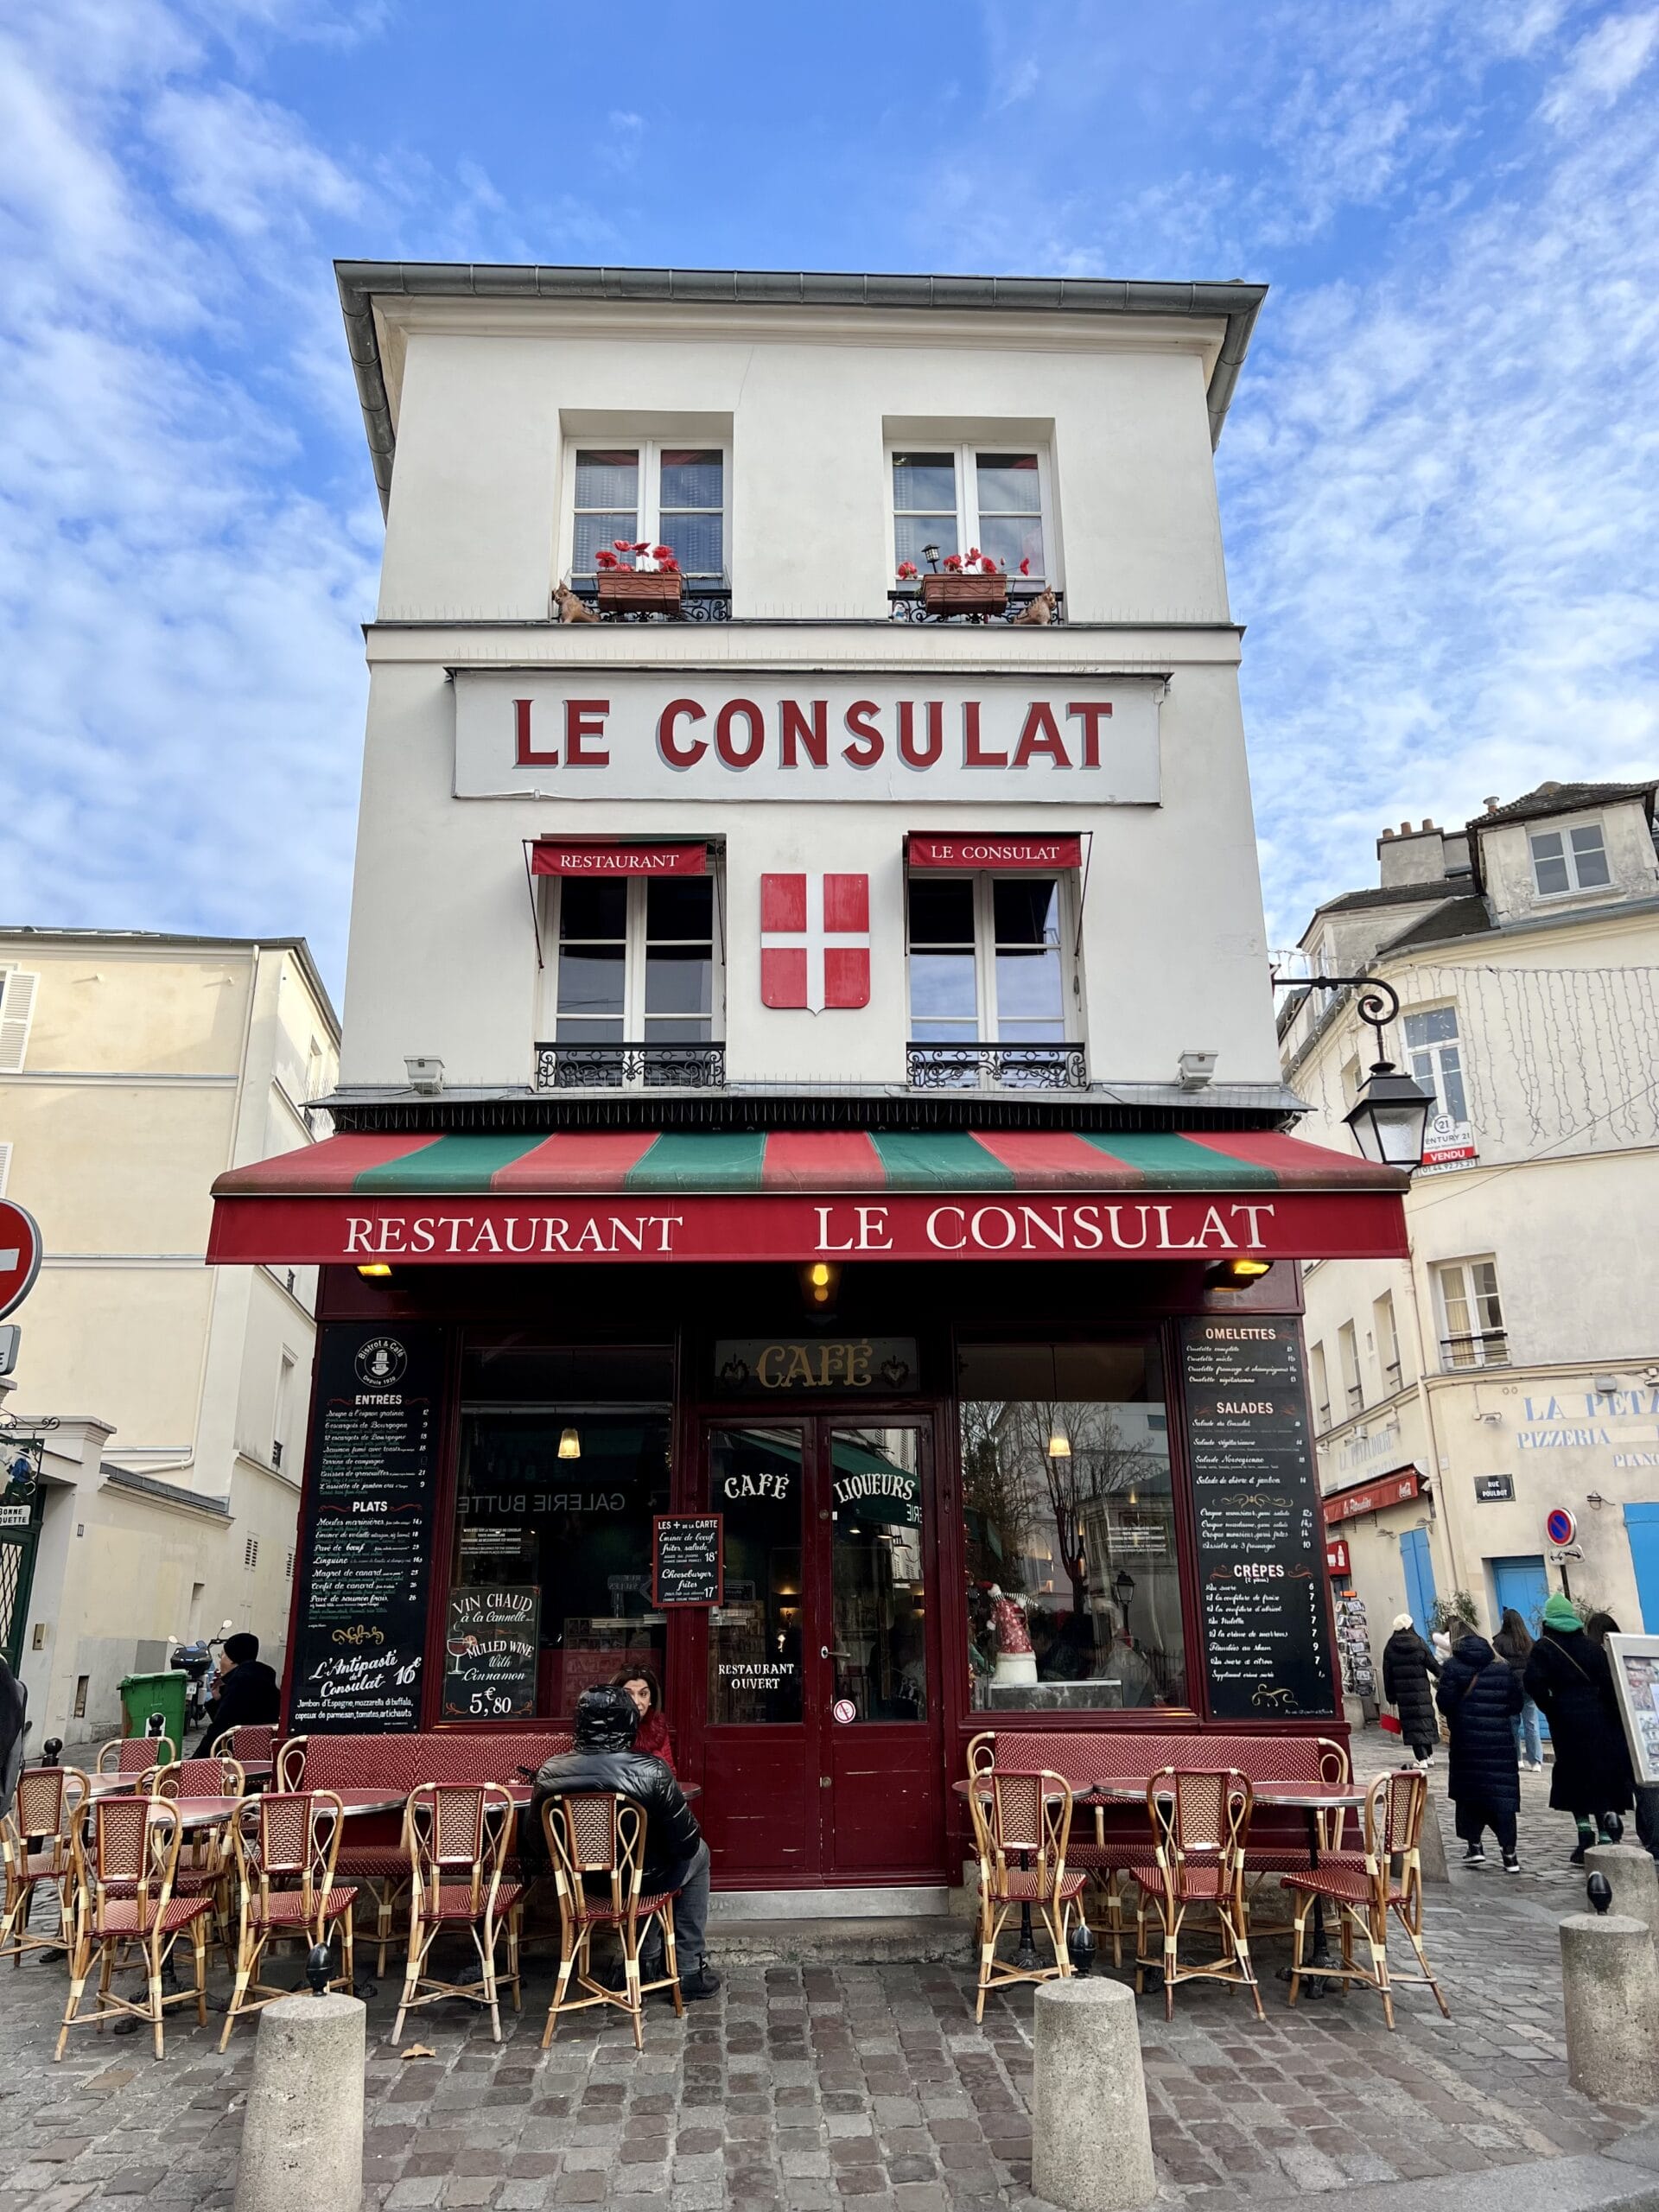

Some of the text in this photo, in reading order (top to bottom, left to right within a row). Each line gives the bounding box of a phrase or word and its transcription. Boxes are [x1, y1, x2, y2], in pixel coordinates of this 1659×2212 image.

[512, 698, 1113, 772] LE CONSULAT
[931, 846, 1059, 860] LE CONSULAT
[560, 855, 679, 868] RESTAURANT
[1425, 1135, 1459, 1144] ENTURY
[1431, 1150, 1465, 1161] VENDU
[813, 1203, 1275, 1250] LE CONSULAT
[342, 1216, 683, 1253] RESTAURANT
[1205, 1329, 1276, 1339] OMELETTES
[359, 1340, 381, 1359] Bistrot
[390, 1343, 405, 1357] Café
[756, 1338, 873, 1389] CAFÉ
[1217, 1402, 1274, 1414] SALADES
[1524, 1395, 1567, 1421] LA
[1517, 1427, 1611, 1448] PIZZERIA
[724, 1473, 790, 1499] CAFÉ
[833, 1473, 916, 1503] LIQUEURS
[353, 1501, 387, 1512] PLATS
[313, 1557, 347, 1566] Linguine
[312, 1569, 341, 1579] Magret
[1234, 1563, 1284, 1577] CRÊPES
[311, 1582, 332, 1592] Confit
[677, 1580, 697, 1591] frites
[453, 1593, 532, 1614] VIN CHAUD
[461, 1611, 526, 1623] à la Cannelle
[467, 1640, 534, 1659] MULLED WINE
[1313, 1643, 1319, 1651] 9
[308, 1649, 397, 1680] L'Antipasti
[488, 1654, 512, 1668] With
[462, 1668, 525, 1681] Cinnamon
[719, 1664, 794, 1675] RESTAURANT
[321, 1674, 385, 1698] Consulat
[732, 1678, 780, 1689] OUVERT
[297, 1699, 320, 1707] Jambon
[296, 1712, 316, 1721] copeaux
[380, 1709, 411, 1718] artichauts
